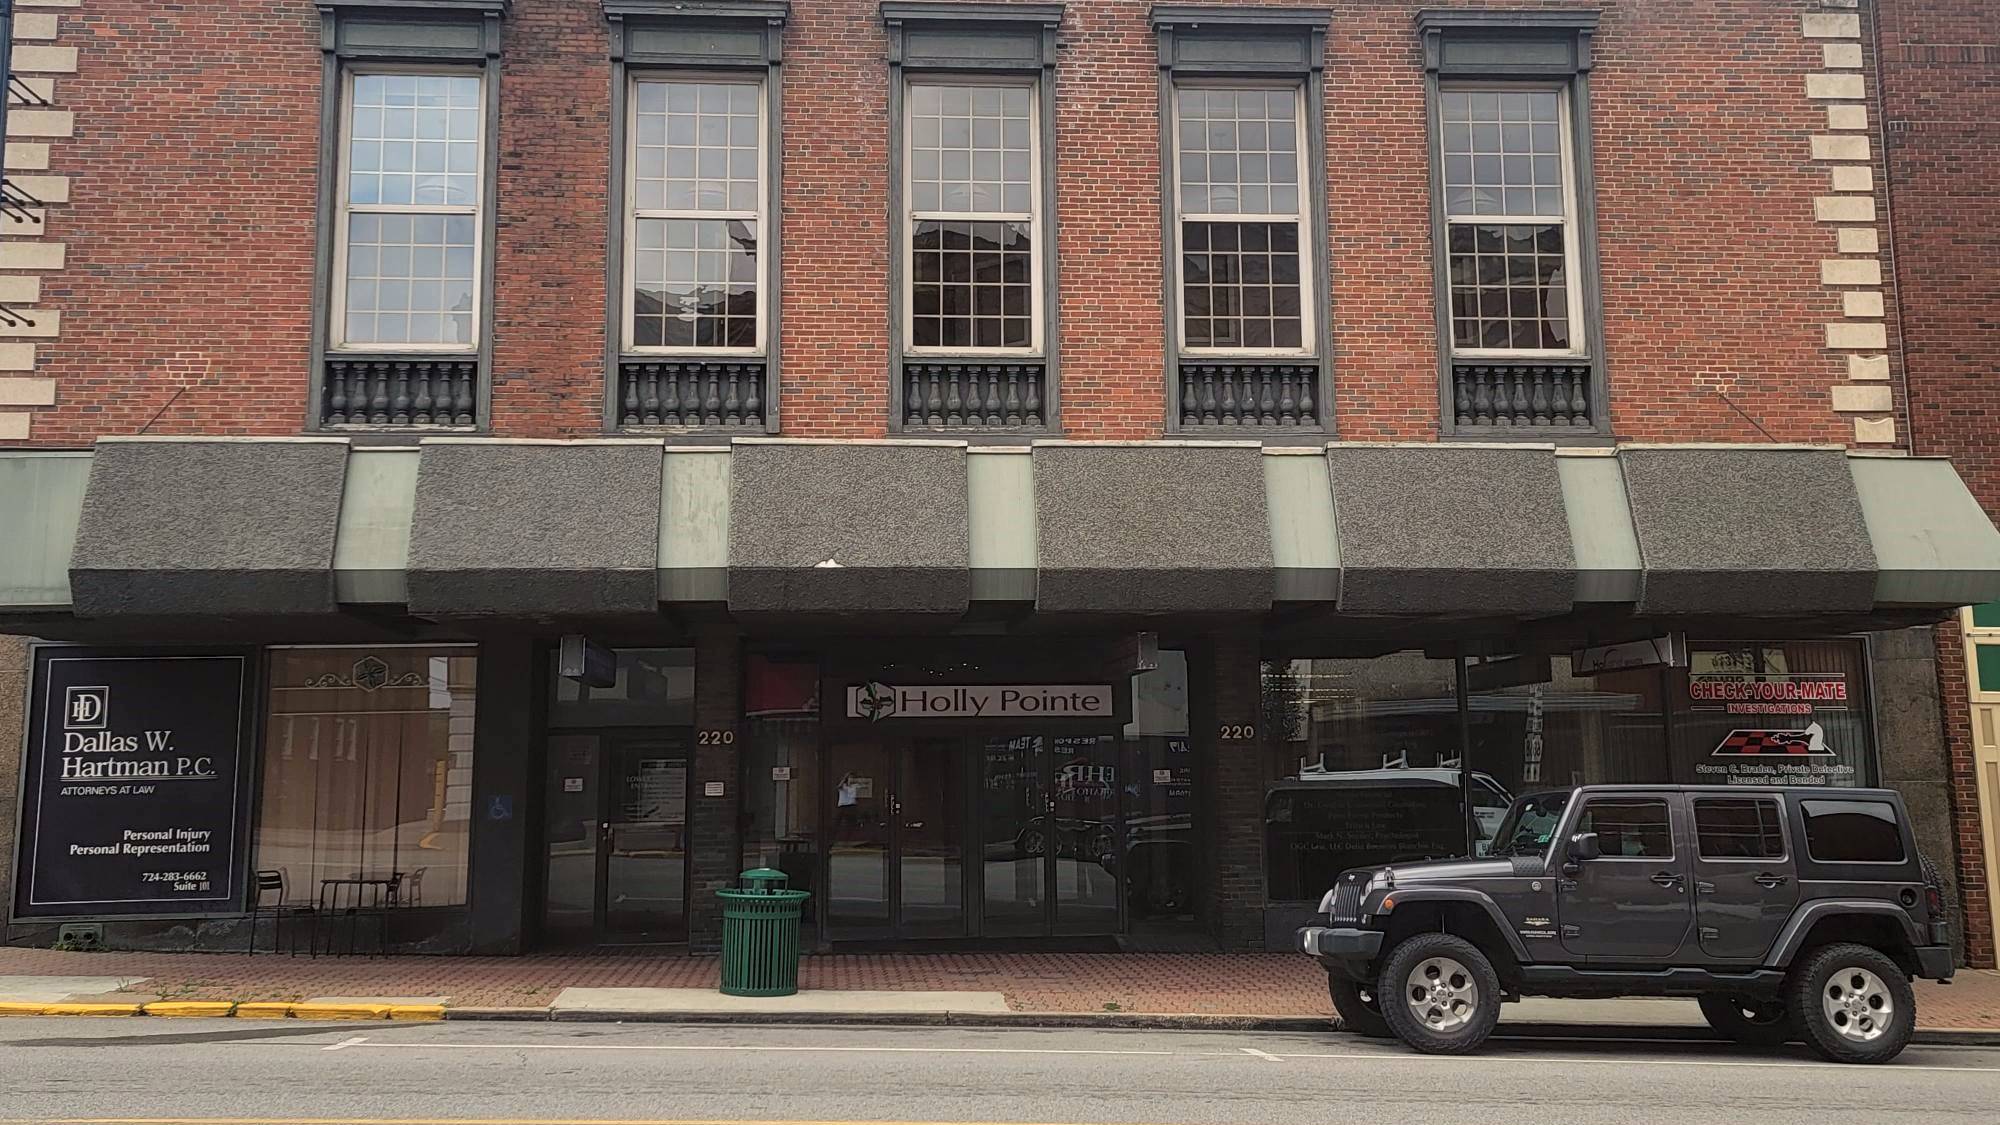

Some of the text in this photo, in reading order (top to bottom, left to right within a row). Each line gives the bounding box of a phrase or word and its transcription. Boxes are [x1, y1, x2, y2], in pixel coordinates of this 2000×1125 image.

[902, 688, 1100, 716] Holly Pointe
[1727, 703, 1812, 714] INVESTIGATIONS
[698, 730, 735, 746] 220
[1220, 724, 1255, 740] 220
[62, 730, 175, 753] Dallas W.
[61, 756, 216, 778] Hartman P.C.
[1695, 764, 1728, 774] Steven
[1777, 763, 1811, 774] Private
[1812, 763, 1855, 774] Detective
[1727, 774, 1826, 785] Licensed and Bonded
[60, 785, 156, 796] ATTORNEYS AT LAW
[123, 827, 212, 842] Personal Injury
[69, 841, 210, 857] Personal Representation
[142, 871, 207, 882] 724-283-6662
[173, 881, 197, 892] Suite
